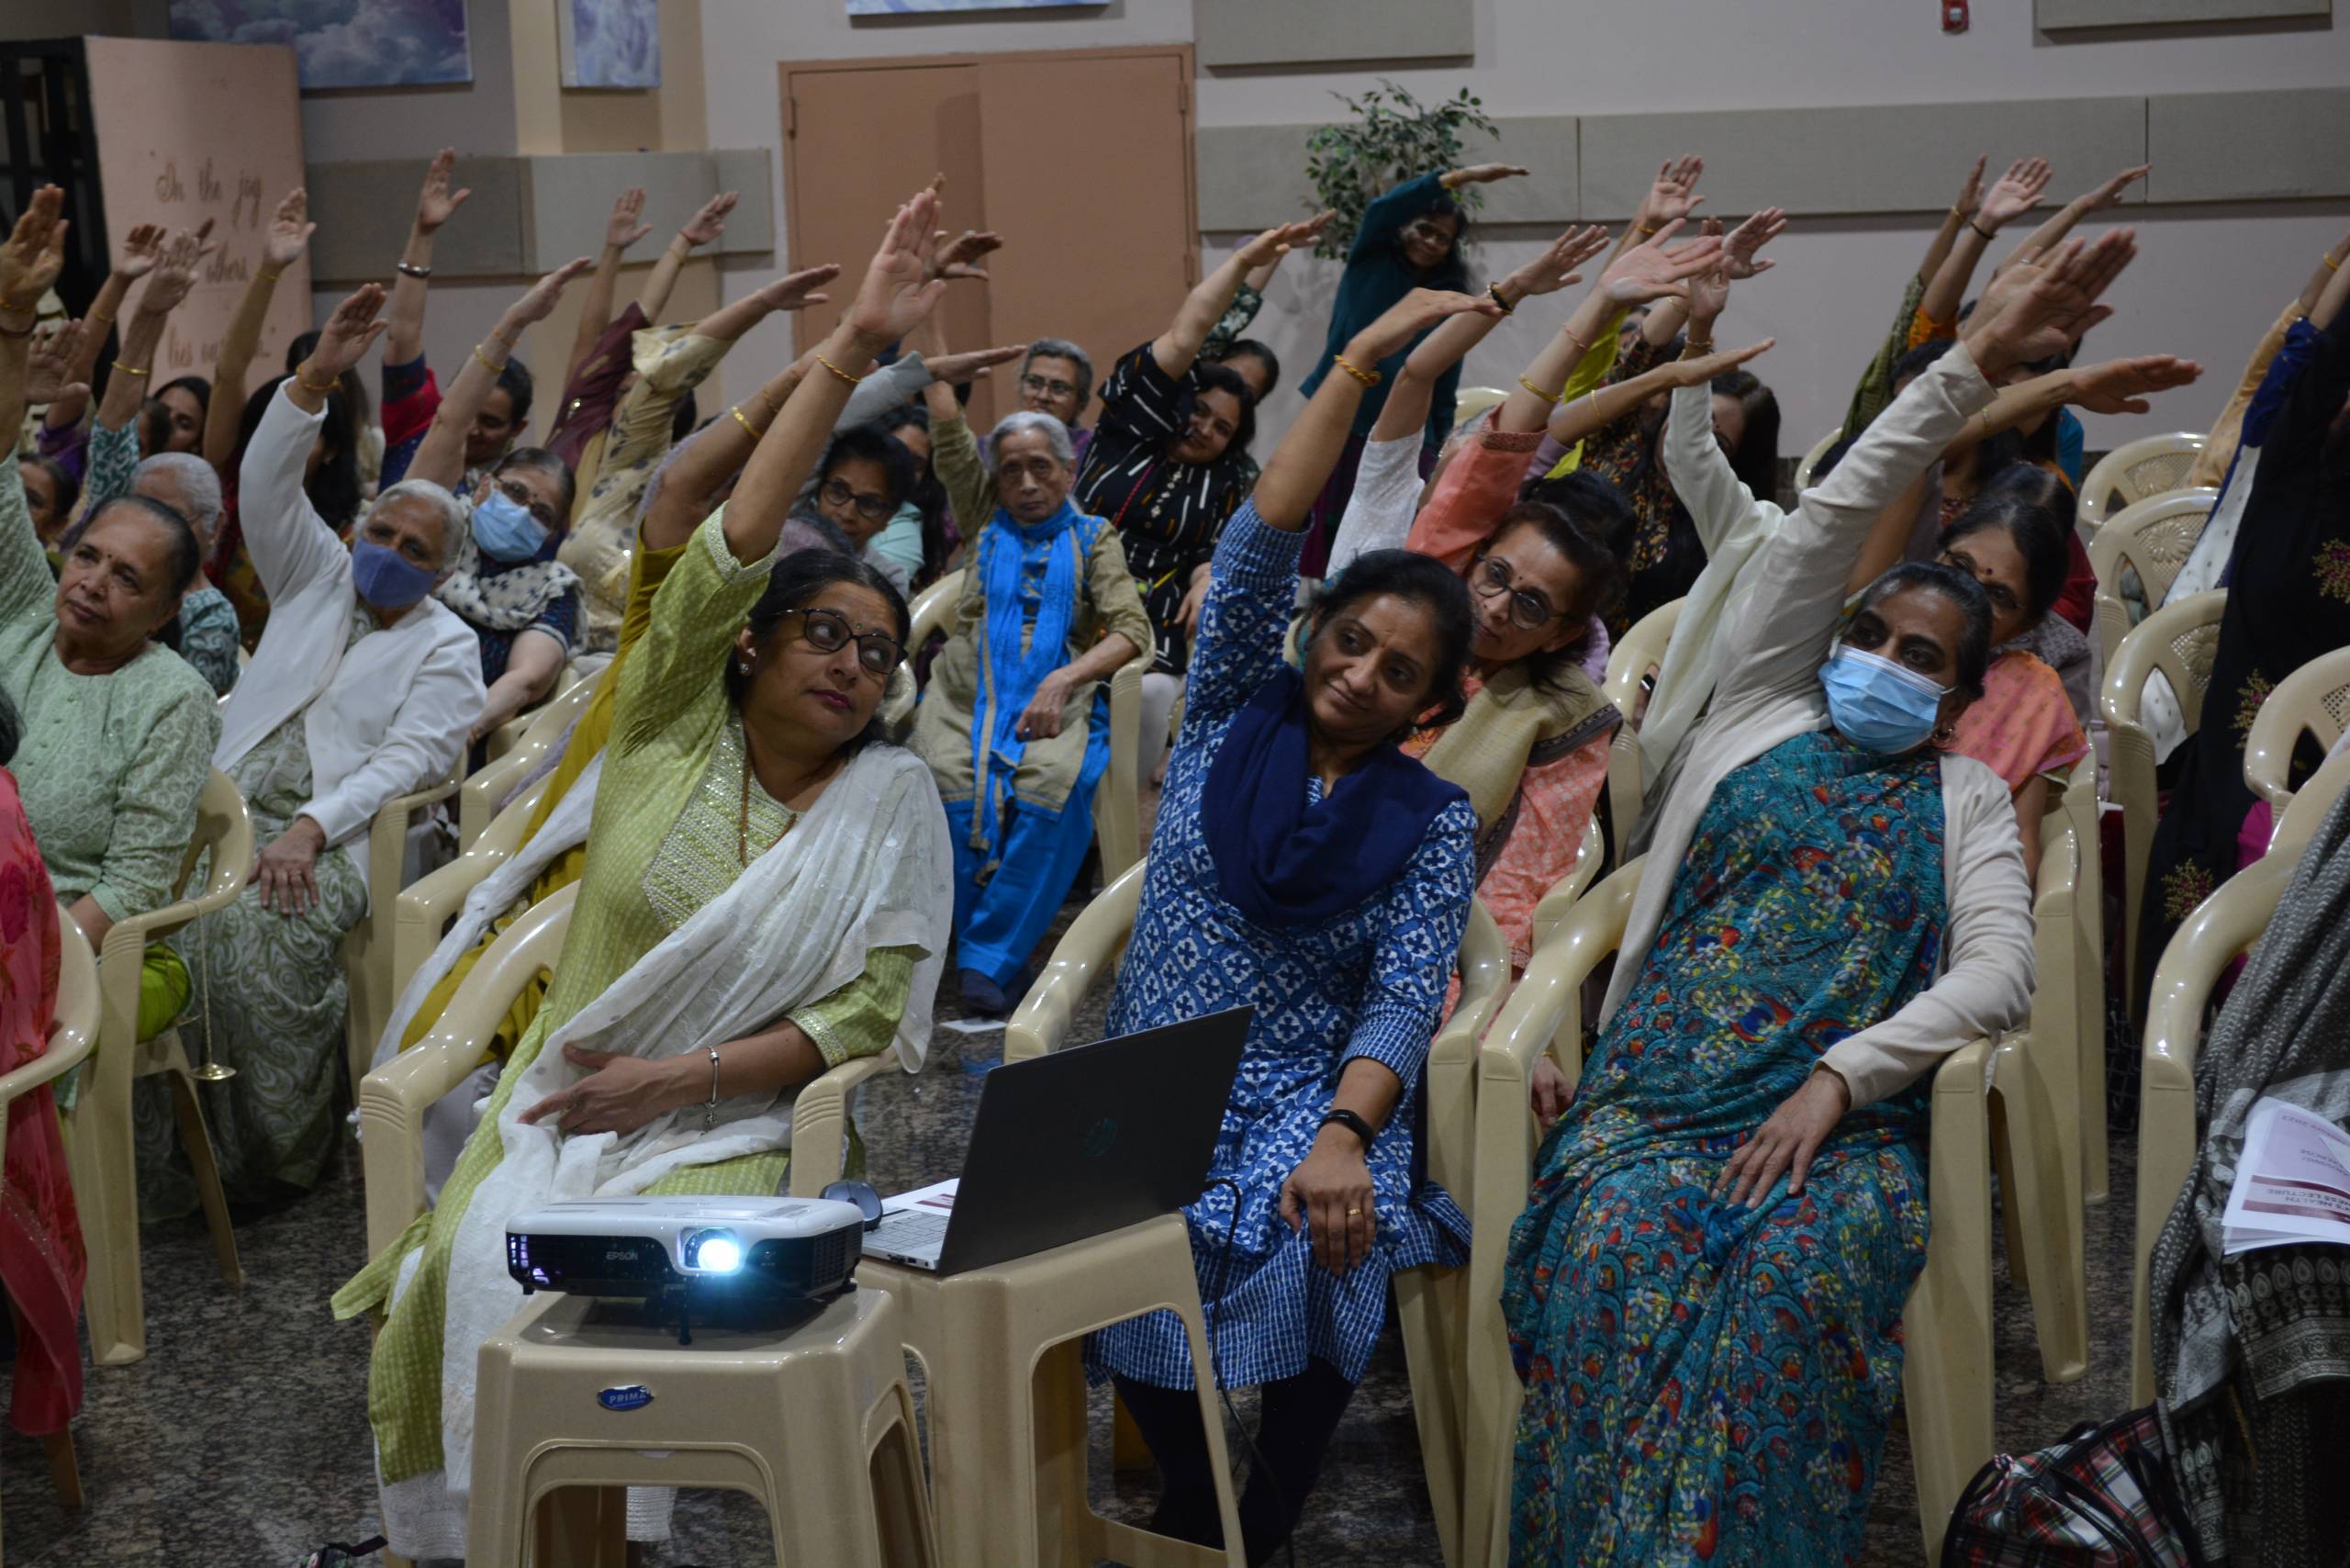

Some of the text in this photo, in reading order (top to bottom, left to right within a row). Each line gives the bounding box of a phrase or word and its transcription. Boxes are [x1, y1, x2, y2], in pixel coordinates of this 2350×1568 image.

[198, 157, 222, 202] the
[231, 169, 262, 230] joy
[2267, 1188, 2322, 1199] LECTURE
[2286, 1196, 2333, 1207] HEALTH
[606, 1251, 638, 1260] EPSON
[610, 1392, 647, 1404] PRIMA
